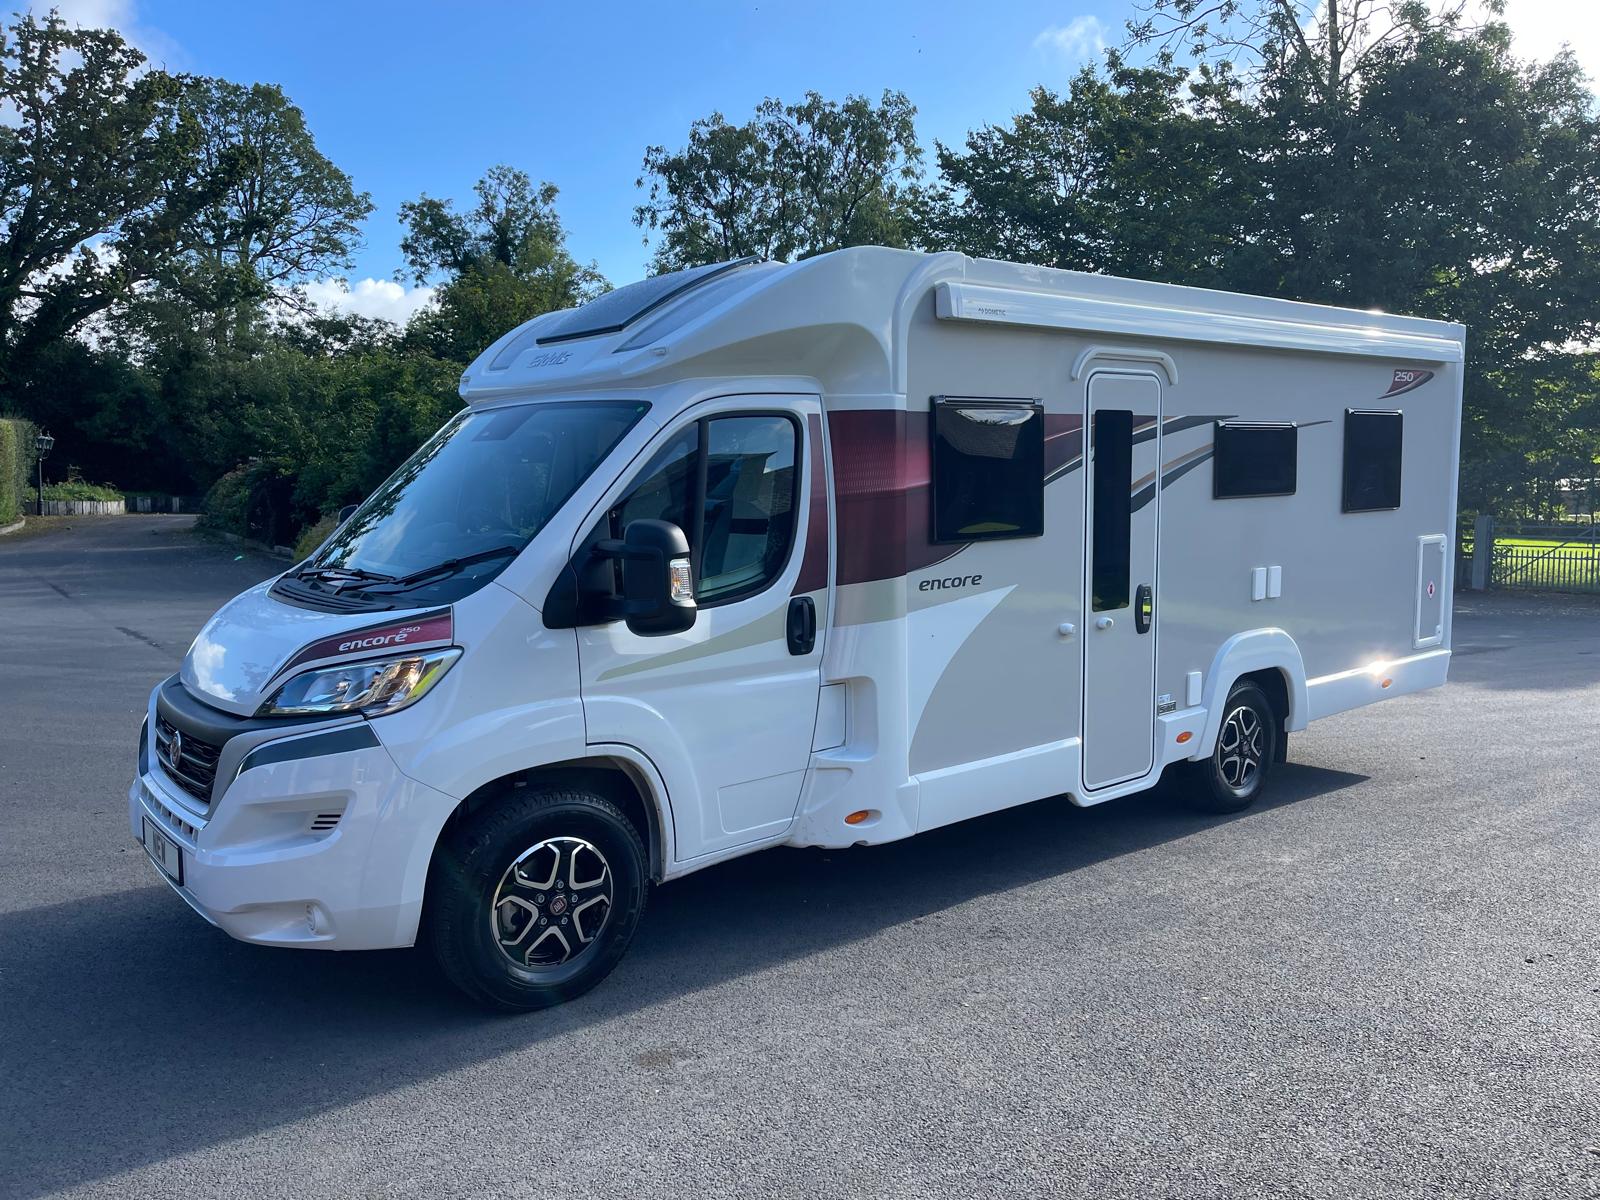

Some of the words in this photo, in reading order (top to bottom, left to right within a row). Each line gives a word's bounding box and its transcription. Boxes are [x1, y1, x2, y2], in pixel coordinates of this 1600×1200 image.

[1394, 371, 1414, 382] 250
[918, 574, 983, 592] encore
[338, 633, 409, 652] encore
[399, 626, 421, 634] 250
